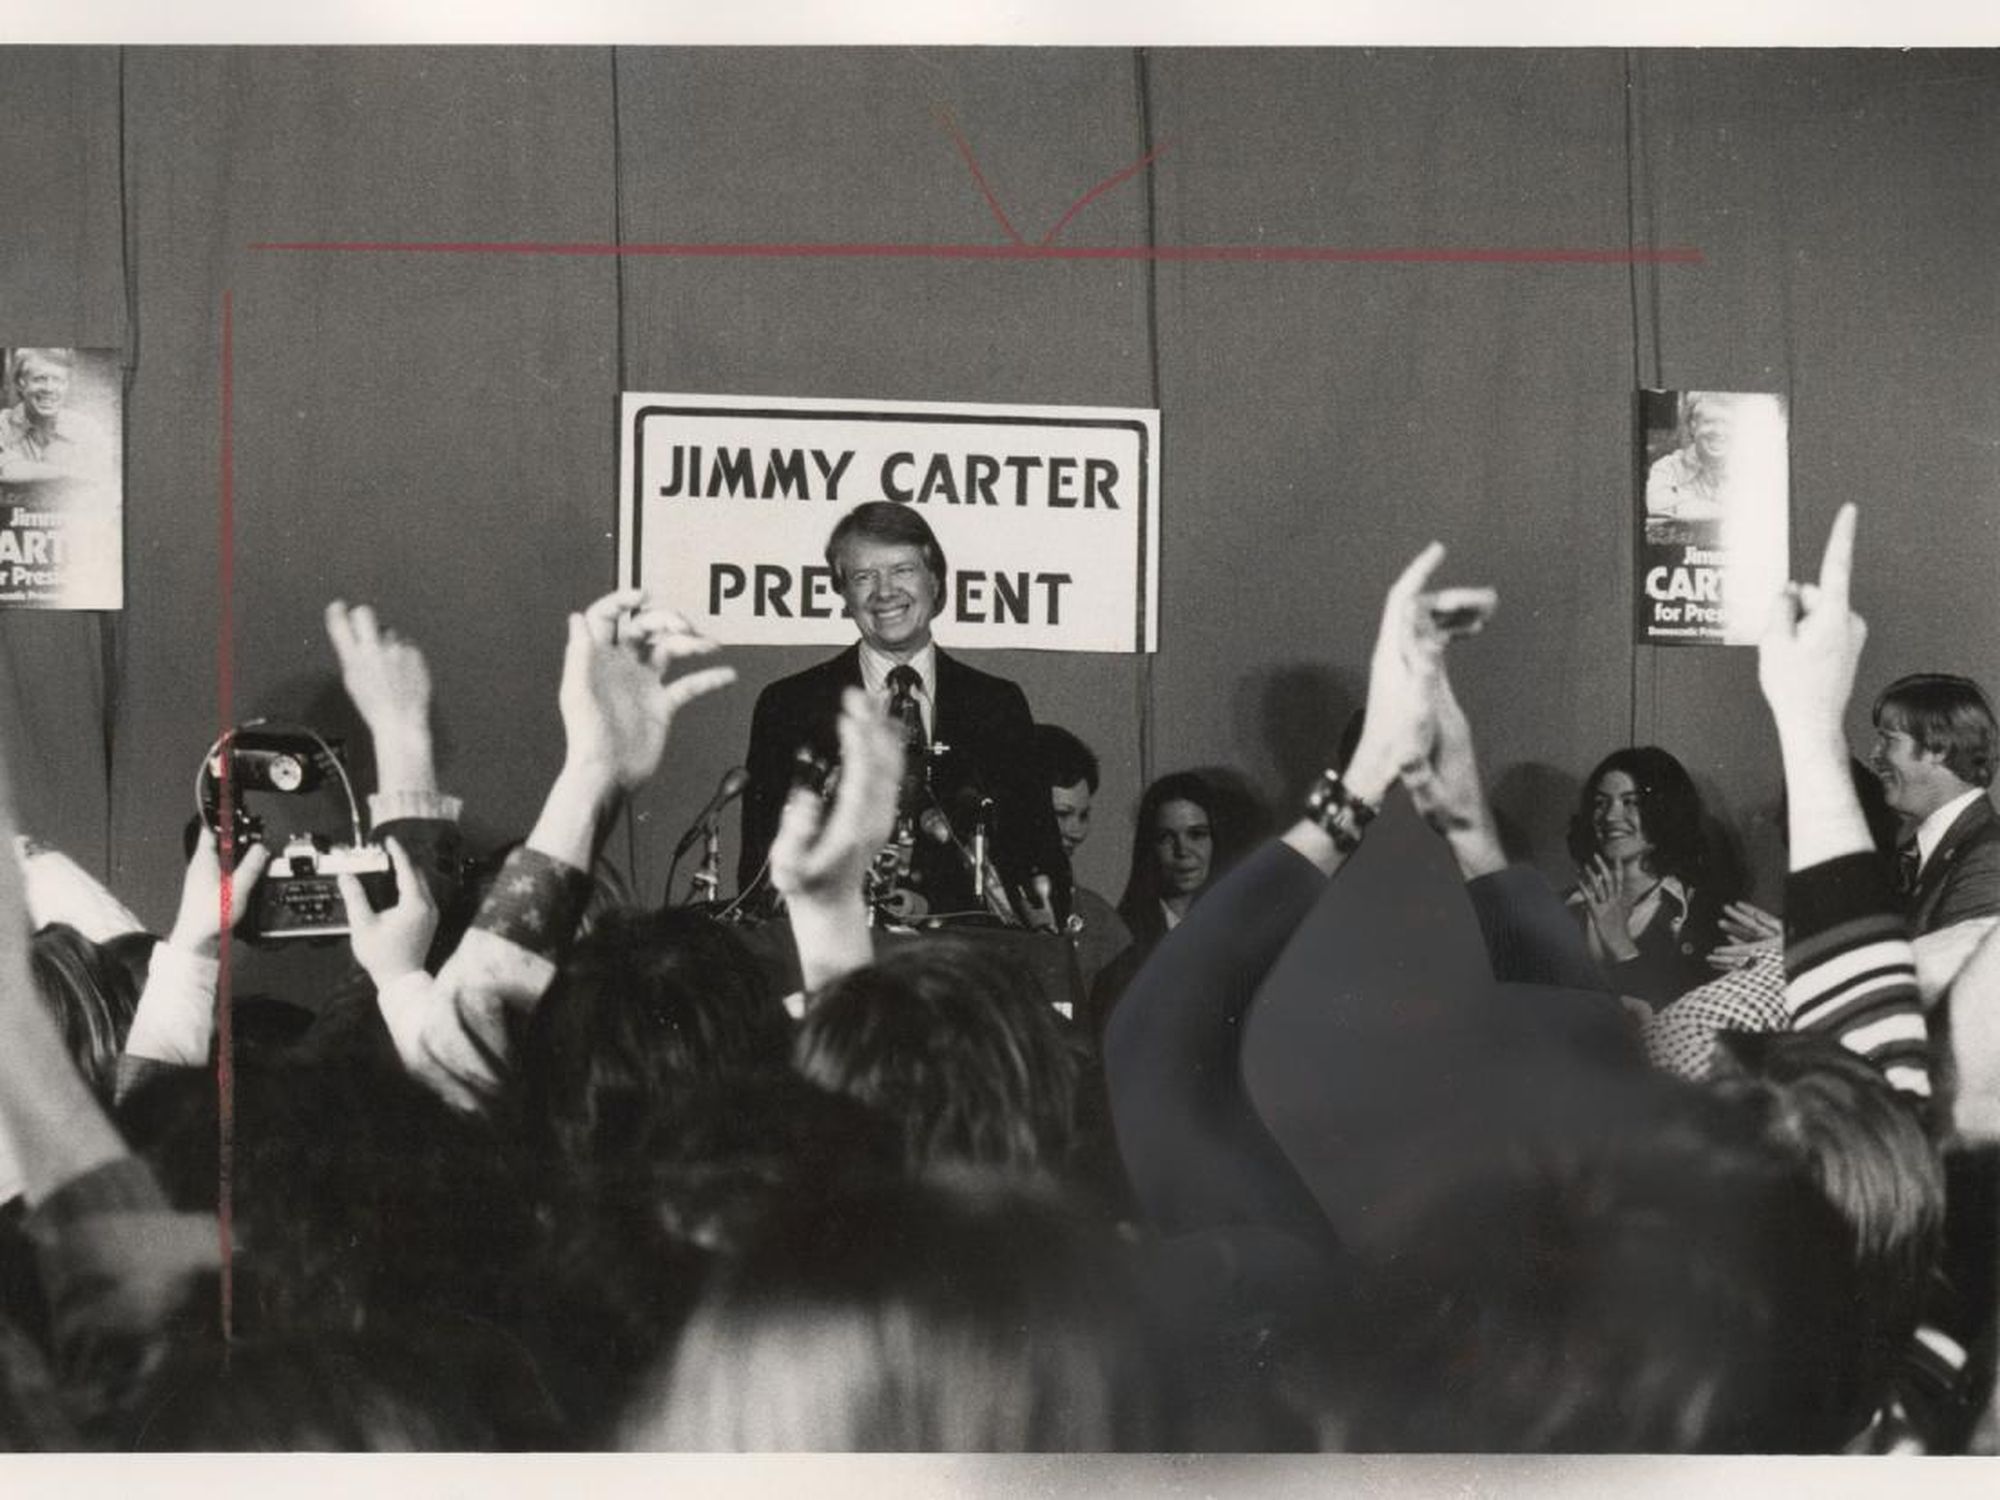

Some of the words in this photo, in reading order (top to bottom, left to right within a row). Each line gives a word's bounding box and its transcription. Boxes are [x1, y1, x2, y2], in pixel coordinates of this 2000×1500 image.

[660, 445, 856, 500] JIMMY
[880, 451, 1121, 510] CARTER
[708, 563, 1073, 625] PREENT
[1654, 602, 1682, 622] for
